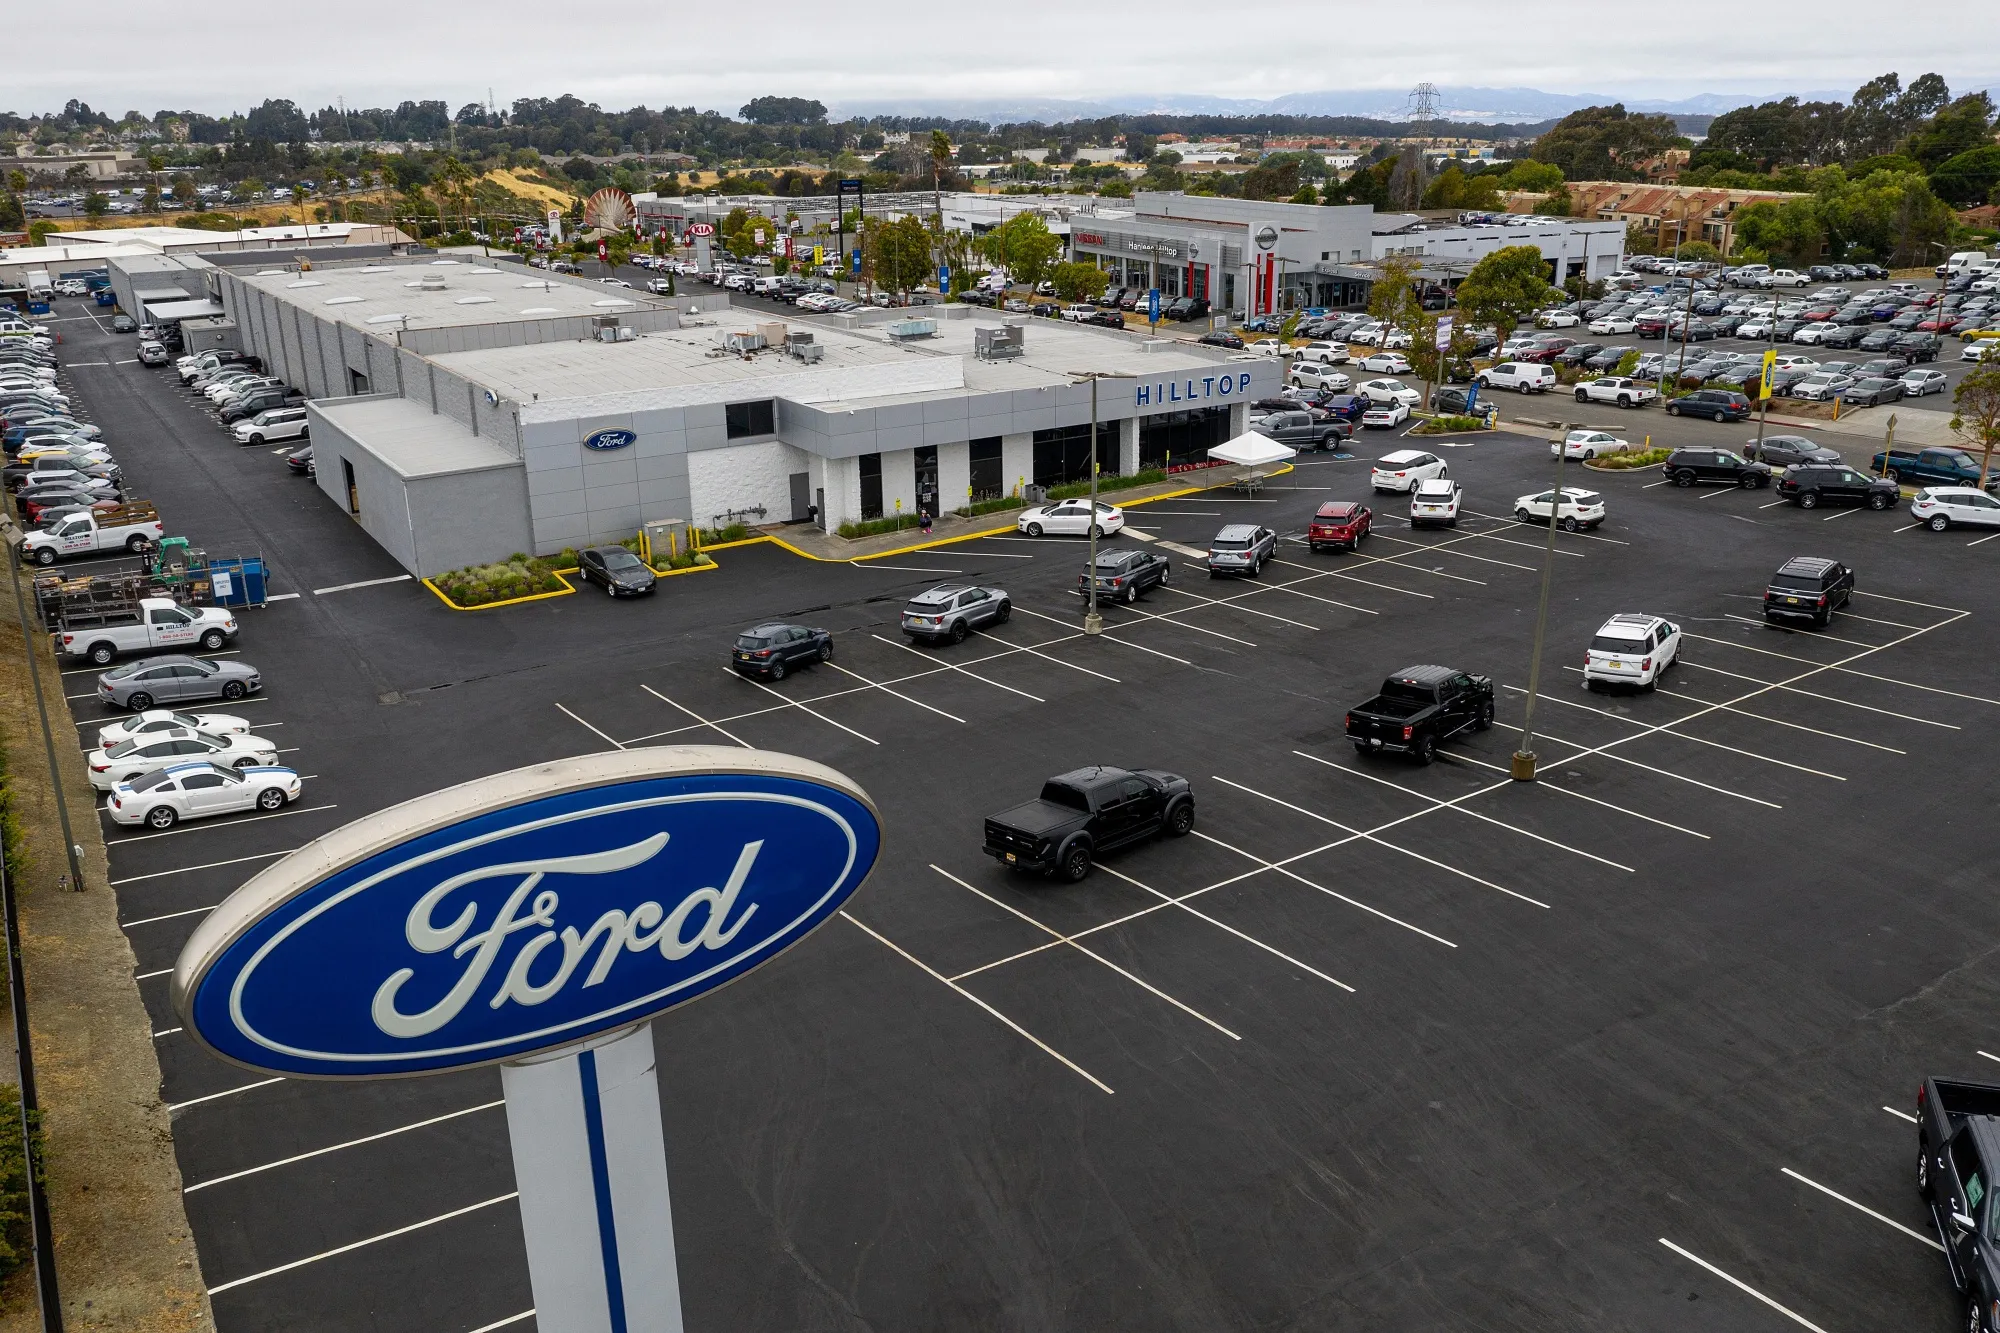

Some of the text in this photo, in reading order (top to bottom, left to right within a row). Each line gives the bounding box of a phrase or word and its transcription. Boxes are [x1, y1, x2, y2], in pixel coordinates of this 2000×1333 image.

[694, 226, 711, 234] KIA
[1075, 232, 1103, 245] NISSAN
[1136, 372, 1251, 406] HILLTOP
[597, 433, 626, 447] Ford
[371, 831, 764, 1039] Ford
